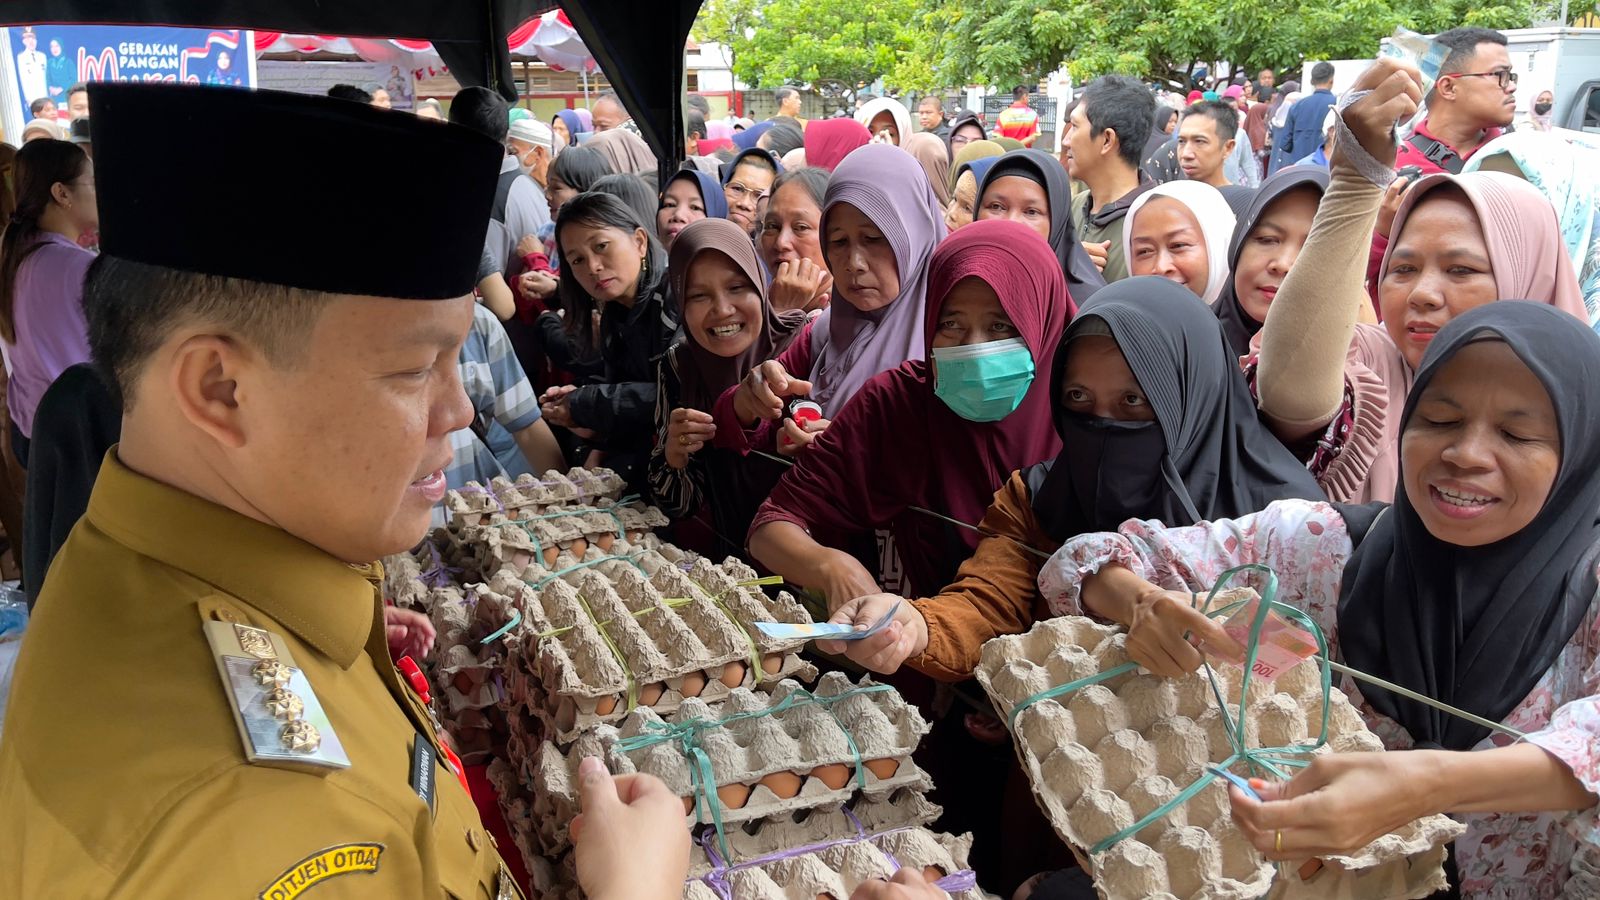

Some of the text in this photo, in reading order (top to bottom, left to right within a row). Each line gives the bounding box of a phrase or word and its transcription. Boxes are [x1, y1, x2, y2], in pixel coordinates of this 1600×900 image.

[119, 43, 178, 56] GERAKAN
[120, 56, 179, 69] PANGAN
[1252, 663, 1274, 678] 100
[270, 849, 376, 900] DITJEN OTDA
